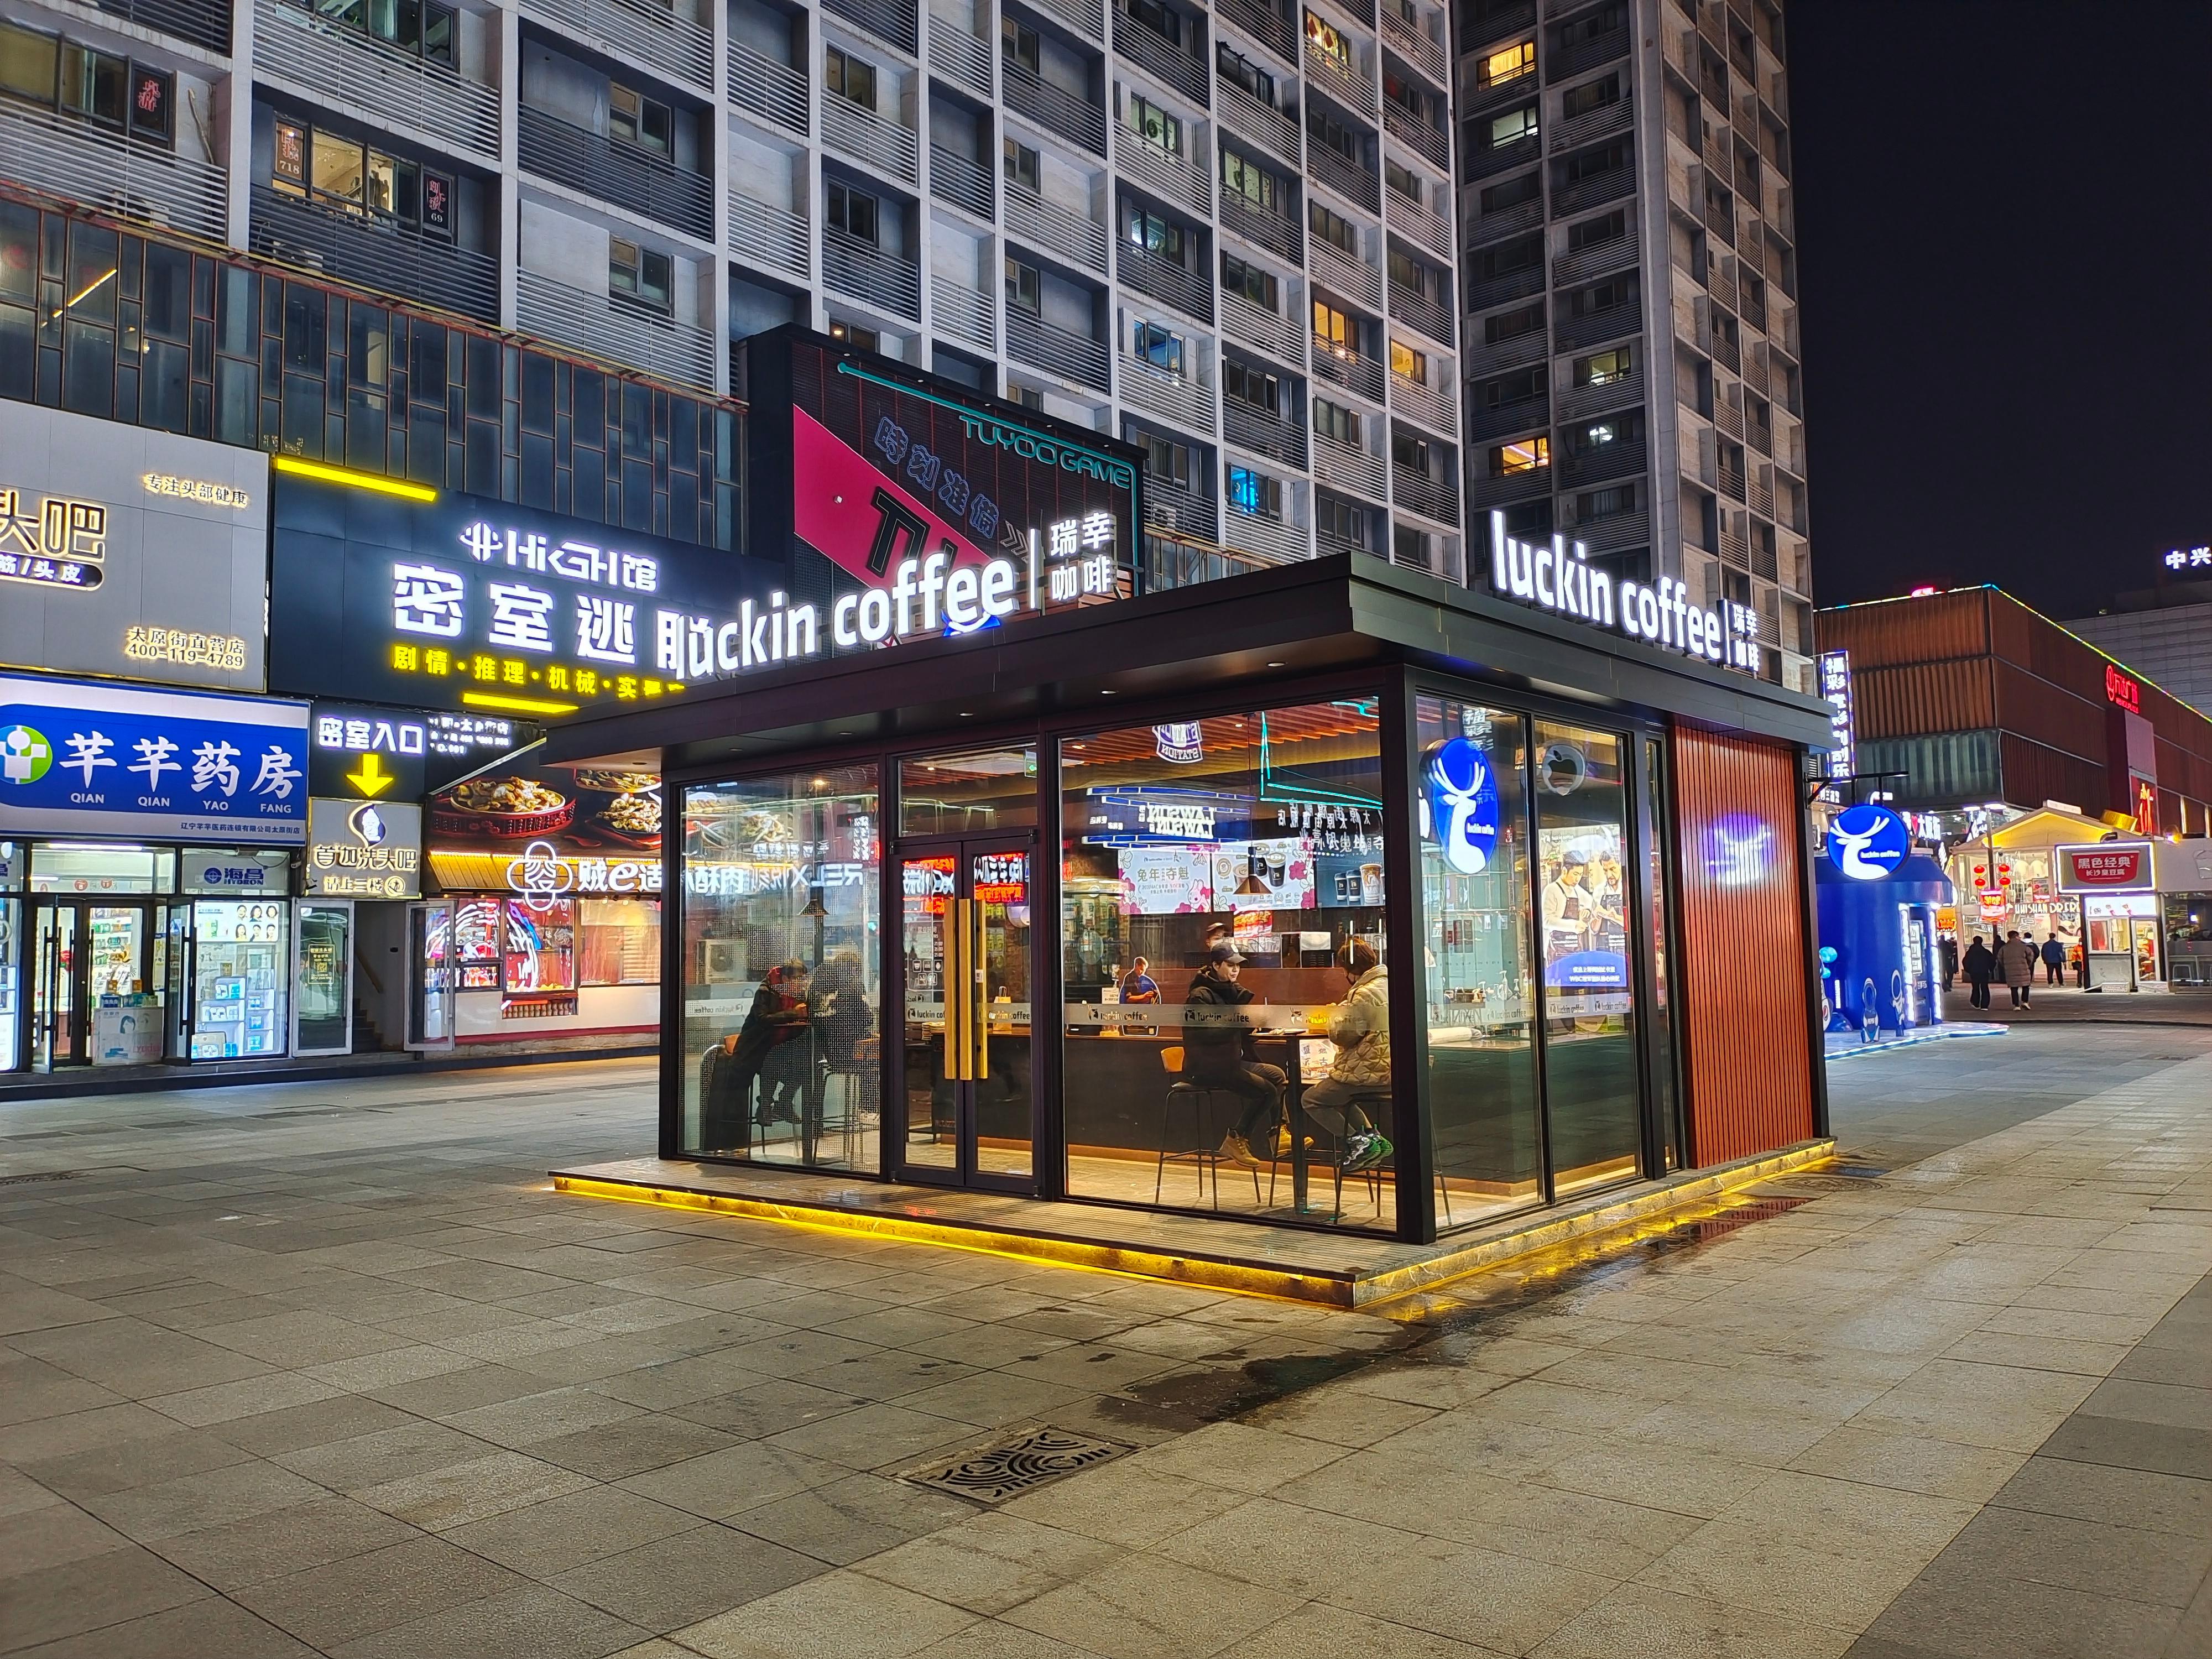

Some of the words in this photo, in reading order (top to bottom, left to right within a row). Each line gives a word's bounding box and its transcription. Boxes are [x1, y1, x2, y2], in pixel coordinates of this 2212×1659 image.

[280, 160, 299, 174] 718
[431, 213, 442, 222] 69
[959, 415, 1056, 465] TUYOO
[1060, 450, 1129, 489] GAME
[144, 473, 248, 508] 专注头部健康
[1051, 512, 1110, 557] 瑞幸
[2166, 545, 2212, 570] 中兴
[1051, 556, 1112, 603] 咖啡
[1493, 509, 1613, 625] luckin
[1620, 576, 1721, 660] coffee
[676, 592, 817, 681] luckin
[833, 553, 1015, 646] coffee
[1731, 603, 1759, 637] 瑞幸
[127, 641, 245, 668] 400-119-4789
[128, 626, 246, 655] 太原街直营店
[1734, 637, 1760, 672] 咖啡
[319, 717, 424, 754] 密室入口
[59, 730, 303, 799] 芊芊药房
[71, 792, 105, 804] QIAN
[138, 796, 170, 807] QIAN
[202, 800, 229, 811] YAO
[260, 803, 292, 814] FANG
[224, 868, 263, 879] 海昌
[1138, 868, 1160, 882] 兔年
[2078, 857, 2131, 869] 黑色经典
[917, 1010, 935, 1019] luckin
